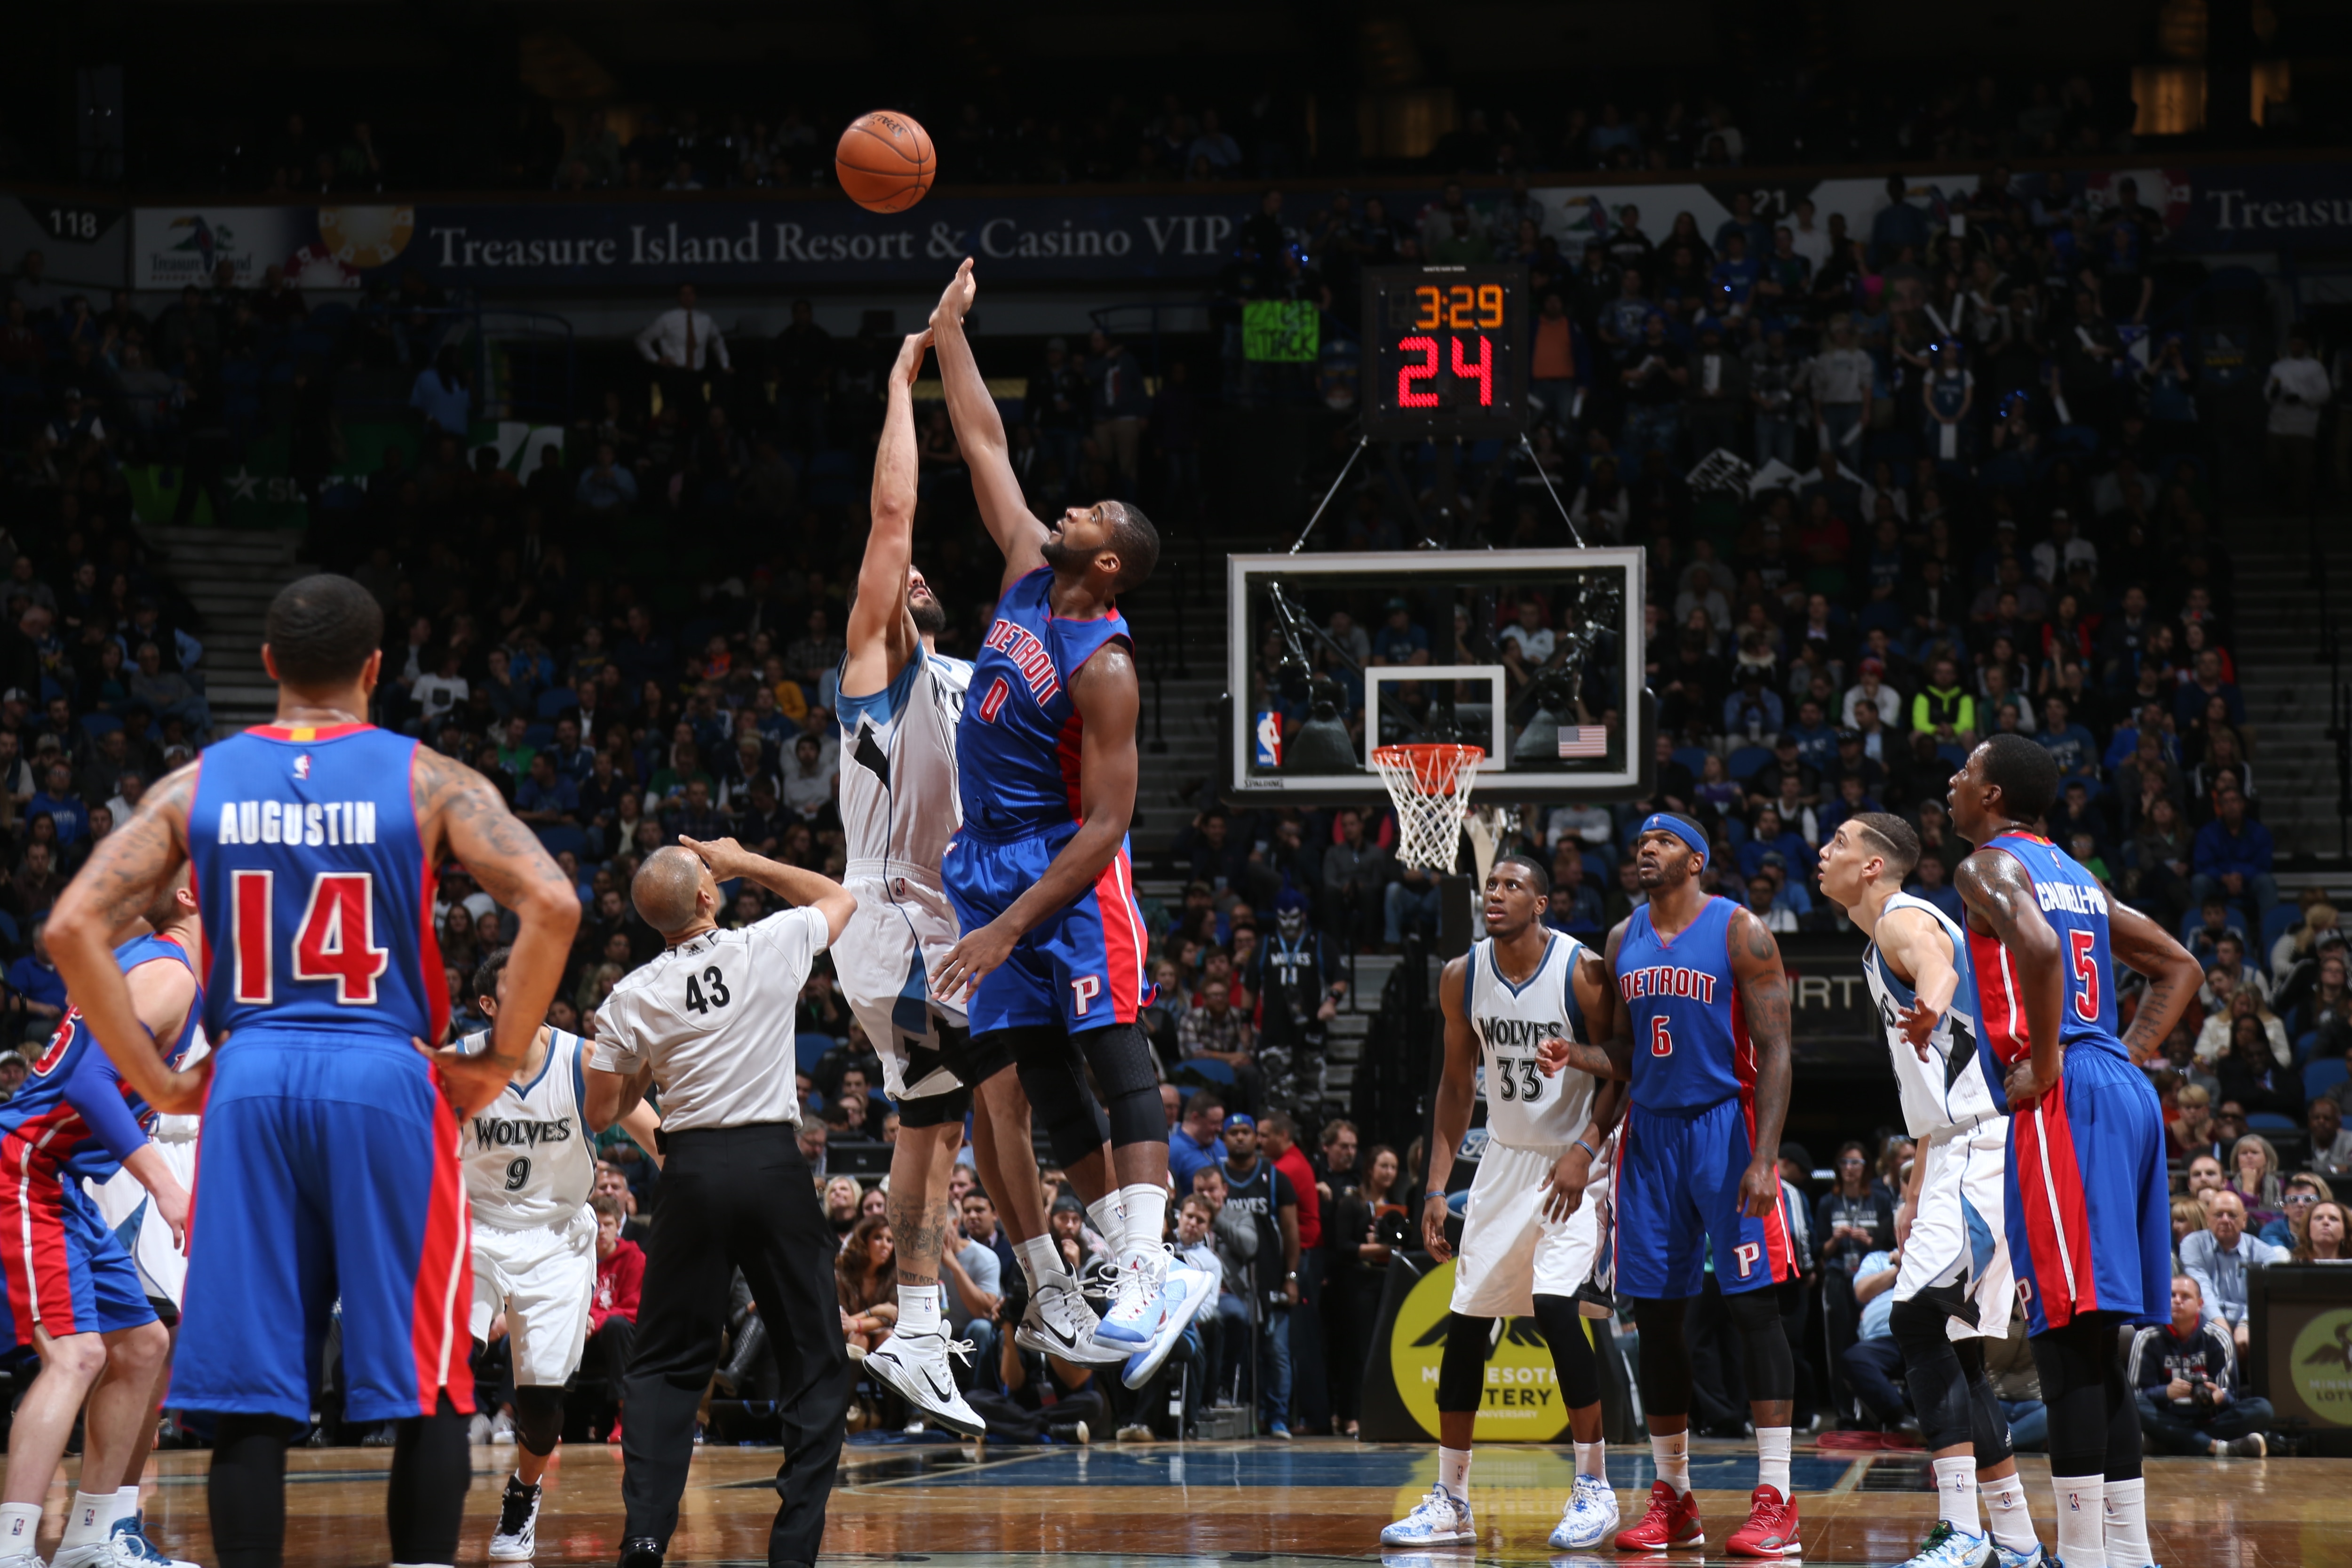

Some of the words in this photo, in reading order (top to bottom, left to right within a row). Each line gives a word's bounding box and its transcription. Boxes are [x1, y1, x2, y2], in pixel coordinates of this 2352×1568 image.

[49, 208, 97, 239] 118
[429, 226, 617, 268] Treasure
[630, 221, 760, 265] Island
[774, 222, 915, 262] Resort
[925, 221, 968, 259] &
[979, 217, 1132, 259] Casino
[1142, 214, 1232, 255] VIP
[1415, 284, 1504, 329] 3:29
[1398, 335, 1493, 408] 24
[984, 618, 1062, 708] DETROIT
[979, 677, 1010, 724] 0
[217, 799, 376, 847] AUGUSTIN
[230, 869, 389, 1005] 14
[686, 966, 730, 1016] 43
[1071, 974, 1101, 1017] P
[1619, 965, 1717, 1004] DETROIT
[2068, 928, 2100, 1023] 5
[1477, 1016, 1563, 1054] WOLVES
[1651, 1014, 1673, 1058] 6
[1496, 1056, 1543, 1102] 33
[471, 1116, 572, 1152] WOLVES
[504, 1156, 531, 1192] 9
[1733, 1241, 1761, 1279] P
